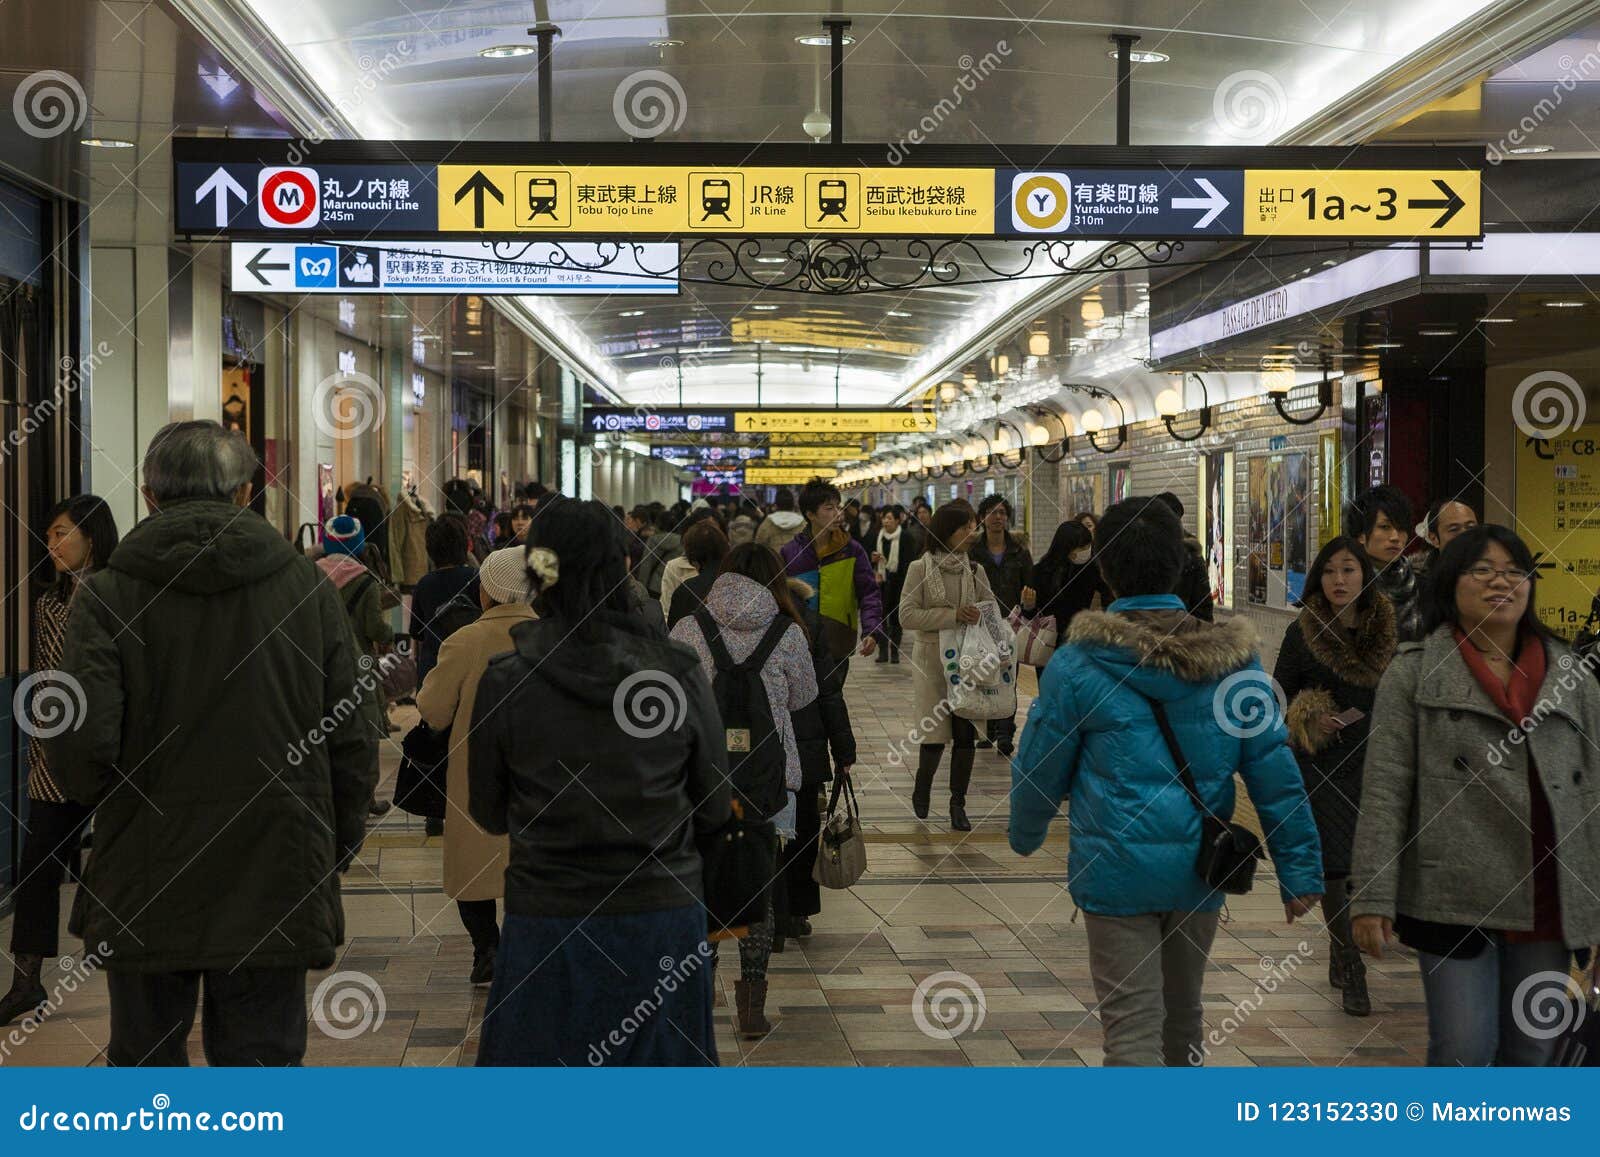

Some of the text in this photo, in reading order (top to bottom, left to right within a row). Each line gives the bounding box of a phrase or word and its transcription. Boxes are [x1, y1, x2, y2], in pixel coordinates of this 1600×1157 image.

[323, 178, 410, 199] 丸ノ内線
[577, 184, 677, 204] 東武東上線
[750, 185, 794, 204] JR線
[866, 185, 966, 205] 西武池袋線
[1074, 182, 1159, 204] 有楽町線
[1259, 187, 1295, 204] 出口
[279, 188, 300, 206] M
[1034, 194, 1049, 212] Y
[323, 200, 419, 211] Marunouchi Line
[577, 205, 654, 217] Tobu Tojo Line
[750, 206, 786, 216] JR Line
[866, 206, 977, 216] Seibu Ikebukuro Line
[1074, 204, 1159, 215] Yurakucho Line
[1259, 204, 1278, 214] Exit
[323, 211, 354, 222] 245m
[1074, 215, 1104, 226] 310m
[386, 260, 445, 275] 駅事務室
[387, 275, 410, 284] Tokyo
[413, 275, 436, 283] Metro
[439, 275, 467, 283] Station
[469, 275, 495, 284] Office,
[497, 275, 515, 283] Lost
[523, 275, 548, 283] Found
[1222, 297, 1250, 337] PASSAGE
[1261, 288, 1288, 325] METRO
[902, 417, 917, 428] C8
[1572, 439, 1600, 456] C8
